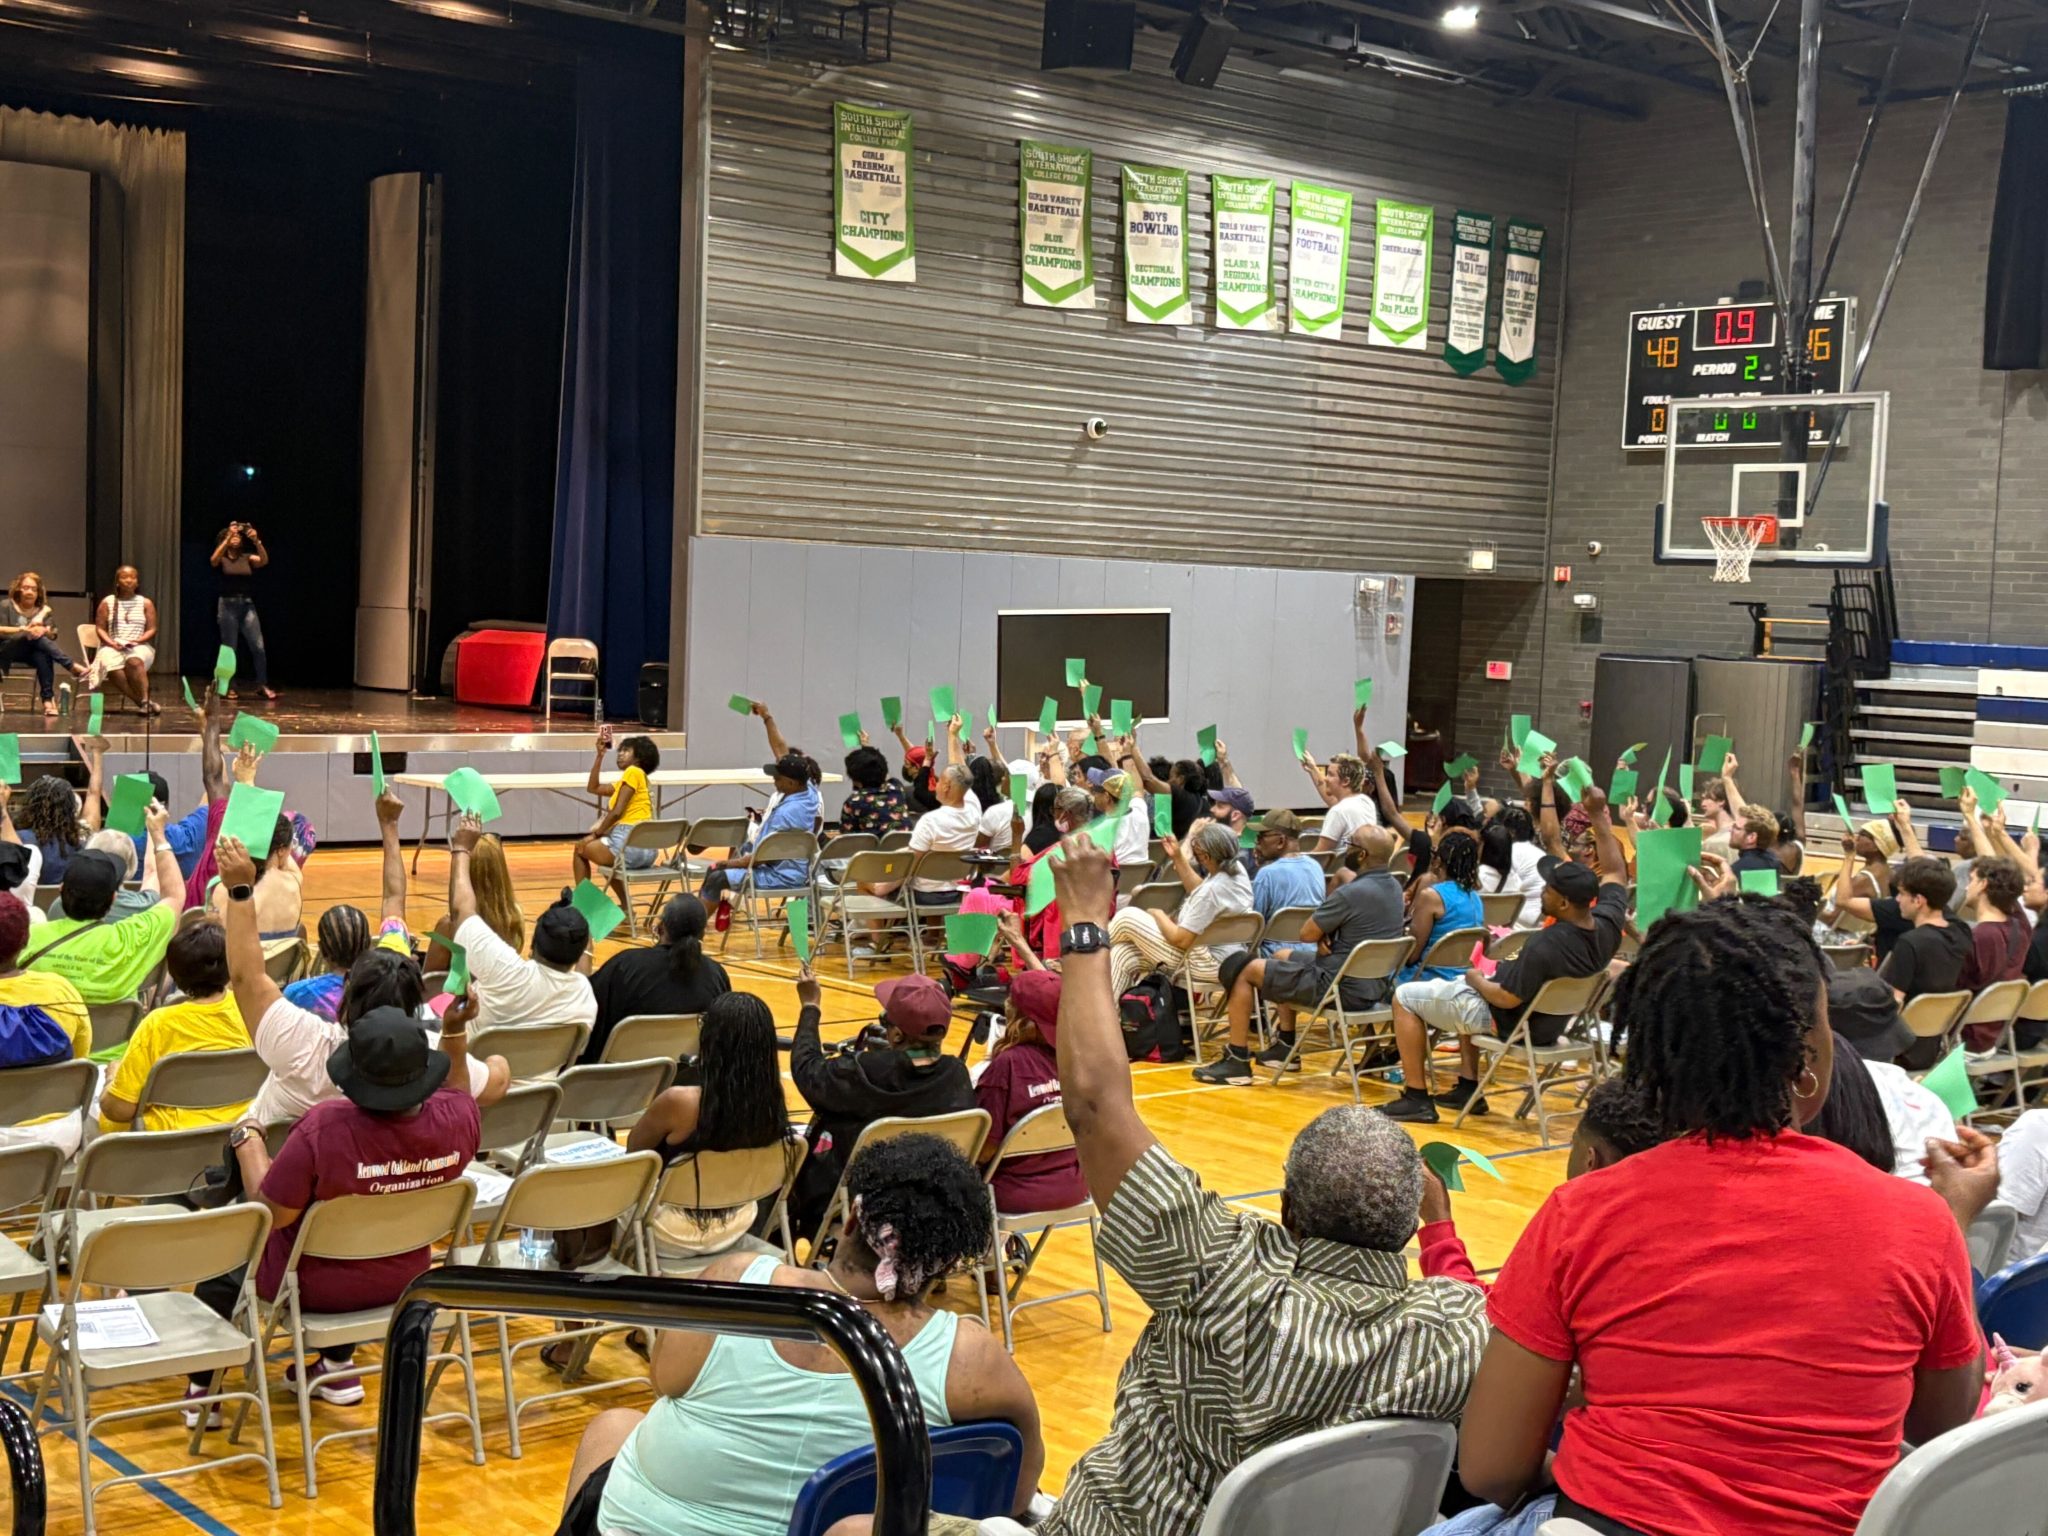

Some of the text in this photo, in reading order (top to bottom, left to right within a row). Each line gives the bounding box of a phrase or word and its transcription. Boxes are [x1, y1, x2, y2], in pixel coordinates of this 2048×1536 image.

[841, 111, 908, 130] SOUTH SHORE
[841, 122, 906, 140] INTERNATIONAL
[862, 150, 884, 160] GIRLS
[1026, 148, 1056, 162] SOUTH
[1026, 160, 1084, 175] INTERNATIONAL
[844, 169, 902, 185] BASKETBALL
[1157, 175, 1183, 186] SHORE
[860, 210, 890, 226] CITY
[1028, 202, 1080, 218] BASKETBALL
[1142, 210, 1168, 222] BOYS
[842, 225, 904, 242] CHAMPIONS
[1130, 222, 1178, 236] BOWLING
[1044, 232, 1064, 243] BLUE
[1220, 232, 1266, 244] BASKETBALL
[1296, 238, 1338, 254] FOOTBALL
[1025, 254, 1082, 270] CHAMPIONS
[1130, 274, 1181, 288] CHAMPIONS
[1224, 270, 1261, 280] REGIONAL
[1506, 269, 1538, 286] FOOTBALL
[1218, 282, 1268, 293] CHAMPIONS
[1394, 304, 1418, 316] PLACE
[1814, 304, 1838, 320] ME
[1637, 314, 1686, 331] GUEST
[1714, 309, 1755, 344] 0.9
[1648, 336, 1680, 368] 48
[1692, 362, 1737, 376] PERIOD
[1744, 355, 1759, 380] 2
[1652, 408, 1664, 432] 0
[1696, 432, 1730, 442] MATCH
[358, 1150, 460, 1178] Kenwood Oakland Community
[370, 1176, 444, 1194] Organization
